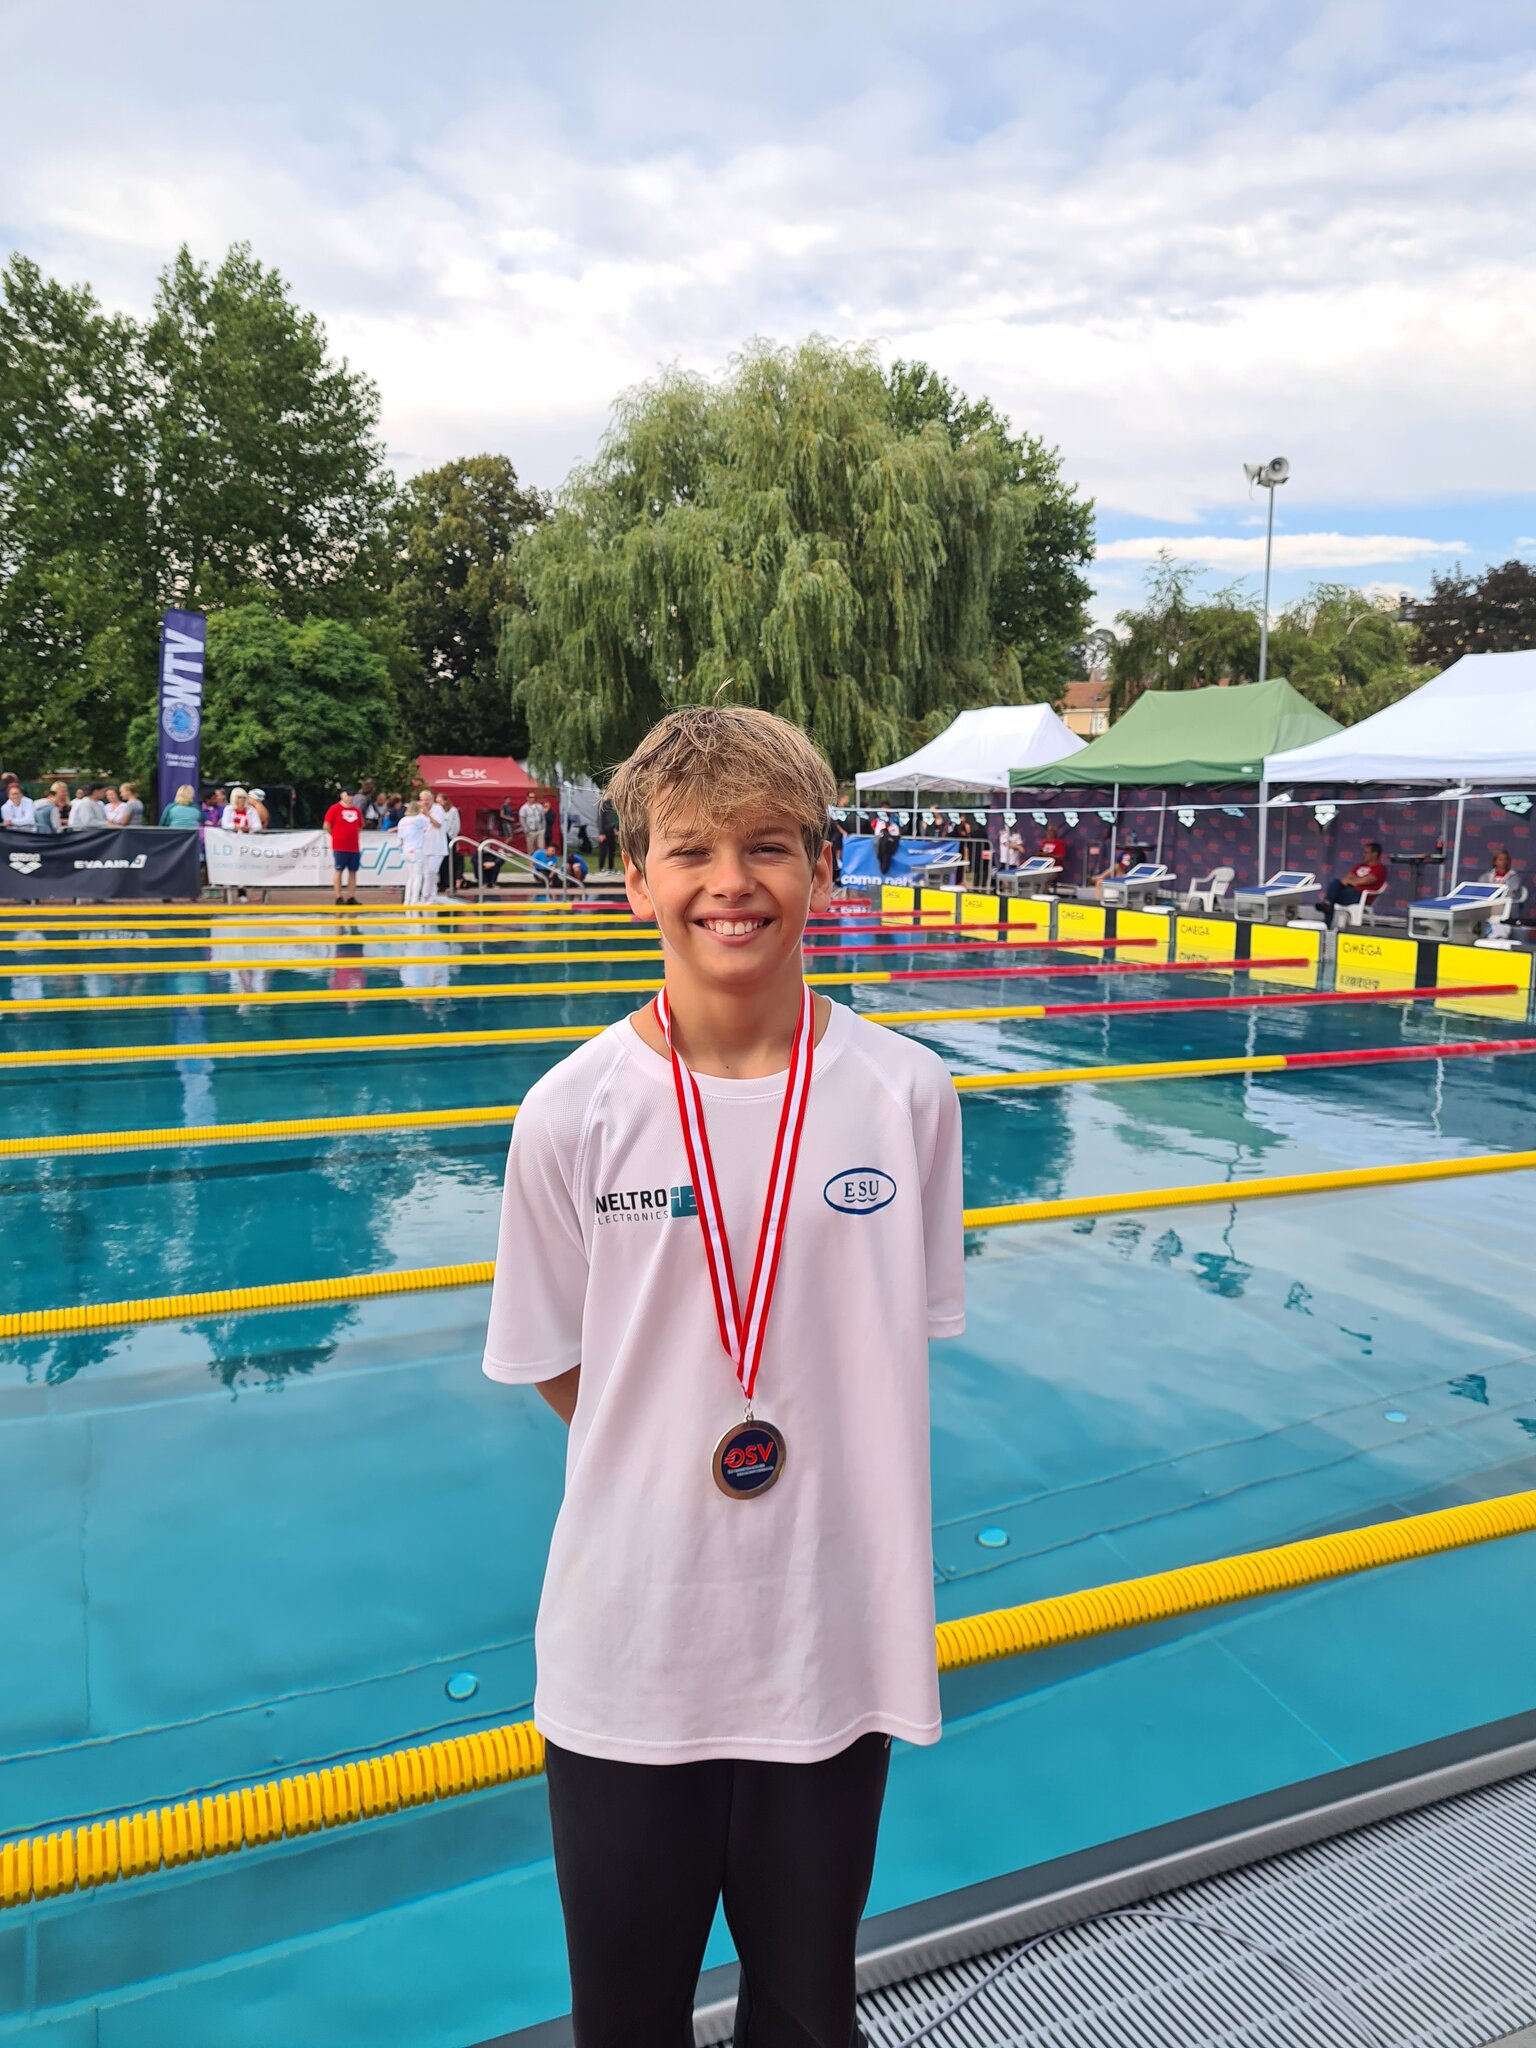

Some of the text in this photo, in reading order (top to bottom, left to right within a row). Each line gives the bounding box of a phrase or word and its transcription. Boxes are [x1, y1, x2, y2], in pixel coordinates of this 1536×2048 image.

[162, 627, 205, 709] WTV
[447, 768, 488, 780] LSK
[240, 846, 284, 859] POOL
[291, 847, 329, 858] SYST
[1180, 924, 1211, 936] OMEGA
[1342, 942, 1383, 957] OMEGA
[844, 1180, 879, 1197] ESU
[596, 1210, 669, 1226] LECTRONICS
